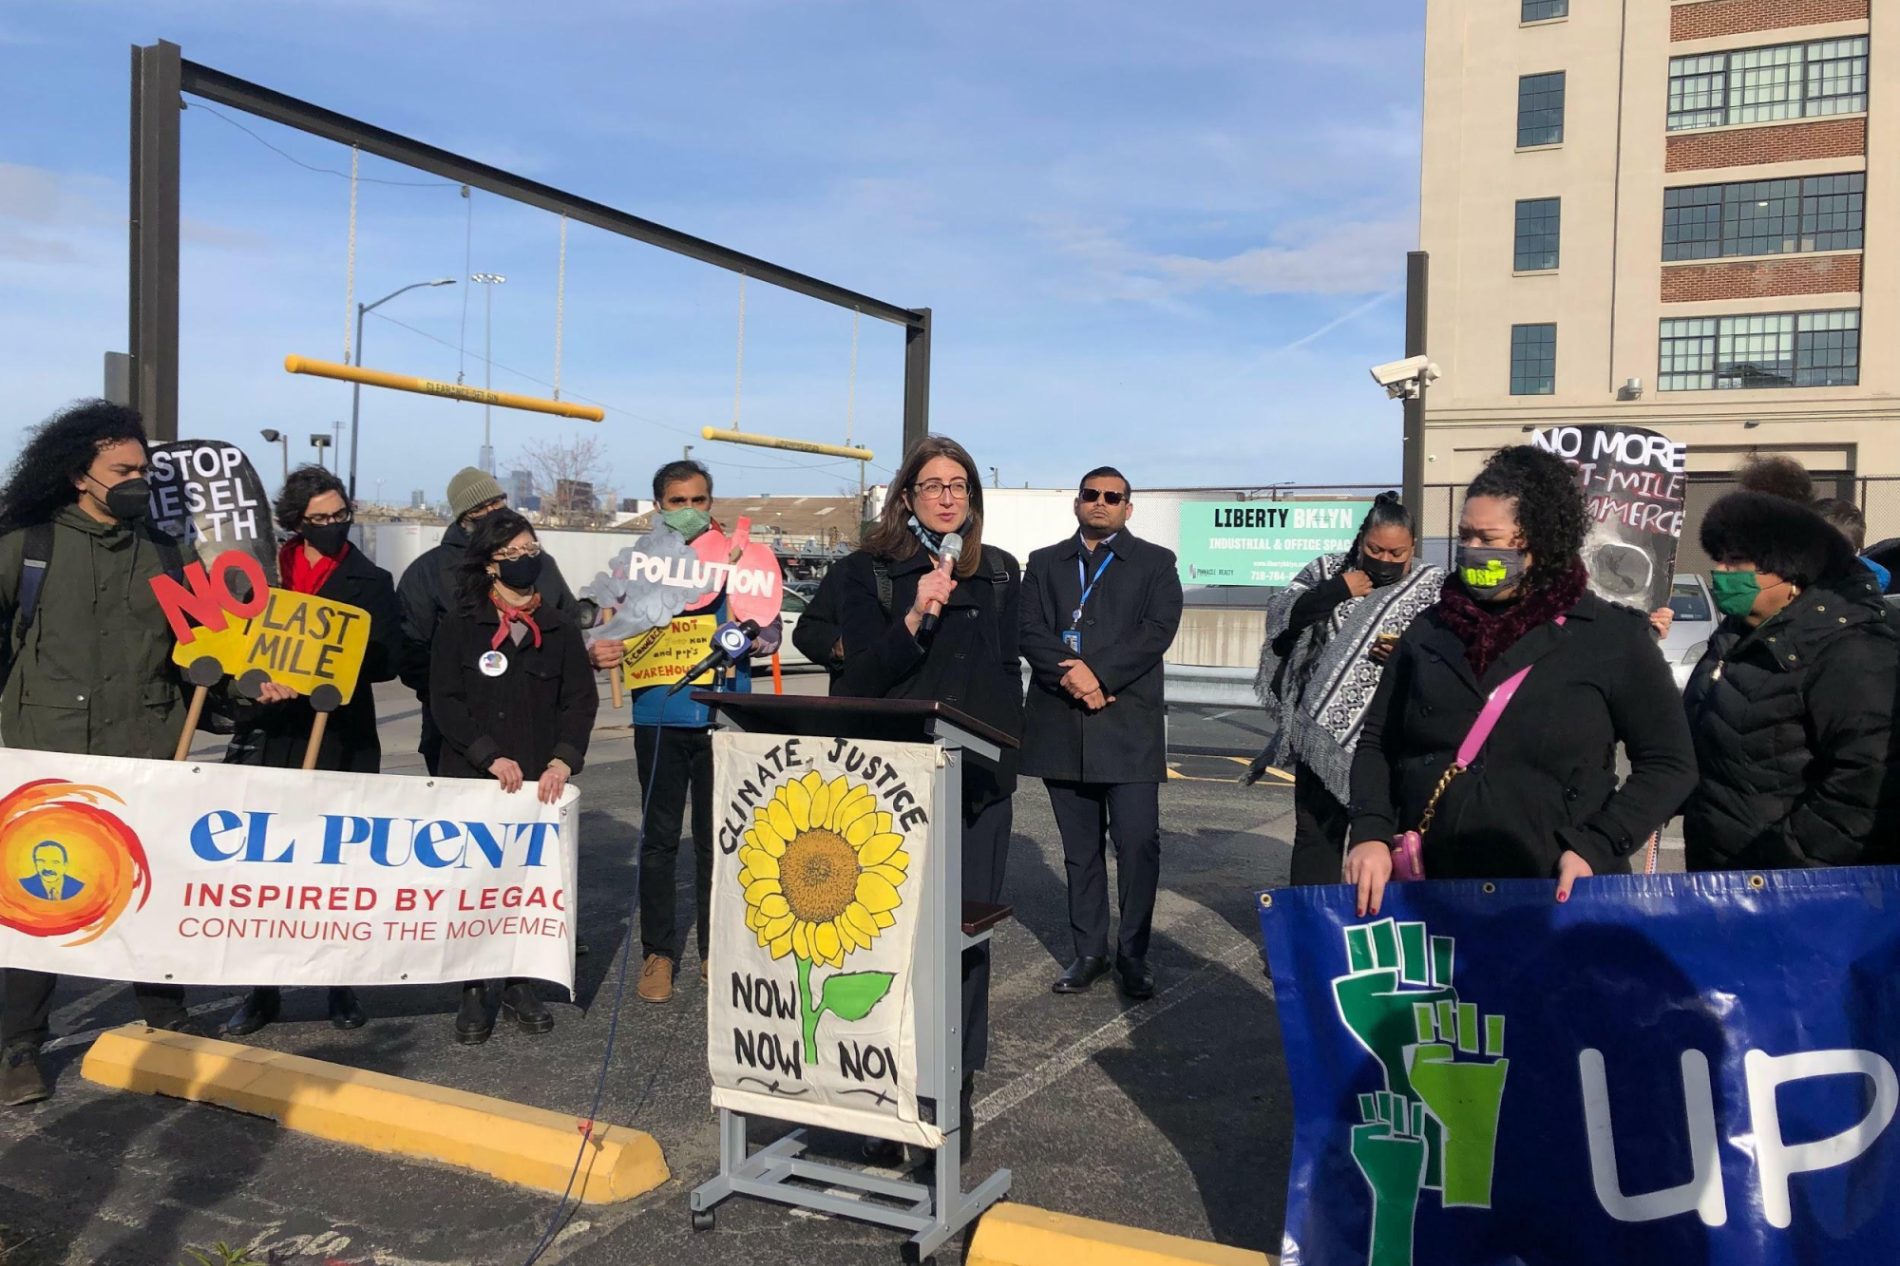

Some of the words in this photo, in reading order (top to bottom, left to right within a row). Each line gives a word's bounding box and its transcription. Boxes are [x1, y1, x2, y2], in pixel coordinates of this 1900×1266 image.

[151, 447, 242, 482] STOP
[1531, 427, 1582, 458] NO
[1592, 430, 1687, 473] MORE
[148, 477, 258, 520] IESEL
[1565, 459, 1685, 501] T-MILE
[1214, 508, 1289, 528] LIBERTY
[1293, 508, 1353, 529] BKLYN
[1209, 537, 1271, 550] INDUSTRIAL
[1273, 538, 1282, 550] &
[1284, 538, 1321, 551] OFFICE
[1323, 538, 1353, 551] SPAC
[629, 551, 775, 598] POLLUTION
[148, 550, 269, 646] NO
[262, 594, 360, 645] LAST
[672, 619, 698, 633] NOT
[247, 634, 343, 679] MILE
[631, 664, 710, 680] WAREHOU
[653, 647, 672, 658] and
[828, 737, 928, 832] JUSTICE
[184, 883, 378, 911] INSPIRED
[395, 888, 444, 911] BY
[458, 886, 566, 911] LEGAC
[178, 917, 372, 941] CONTINUING
[384, 921, 437, 940] THE
[446, 916, 568, 940] MOVEMEN
[732, 971, 796, 1020] NOW
[734, 1027, 802, 1080] NOW
[1579, 1048, 1899, 1229] UP
